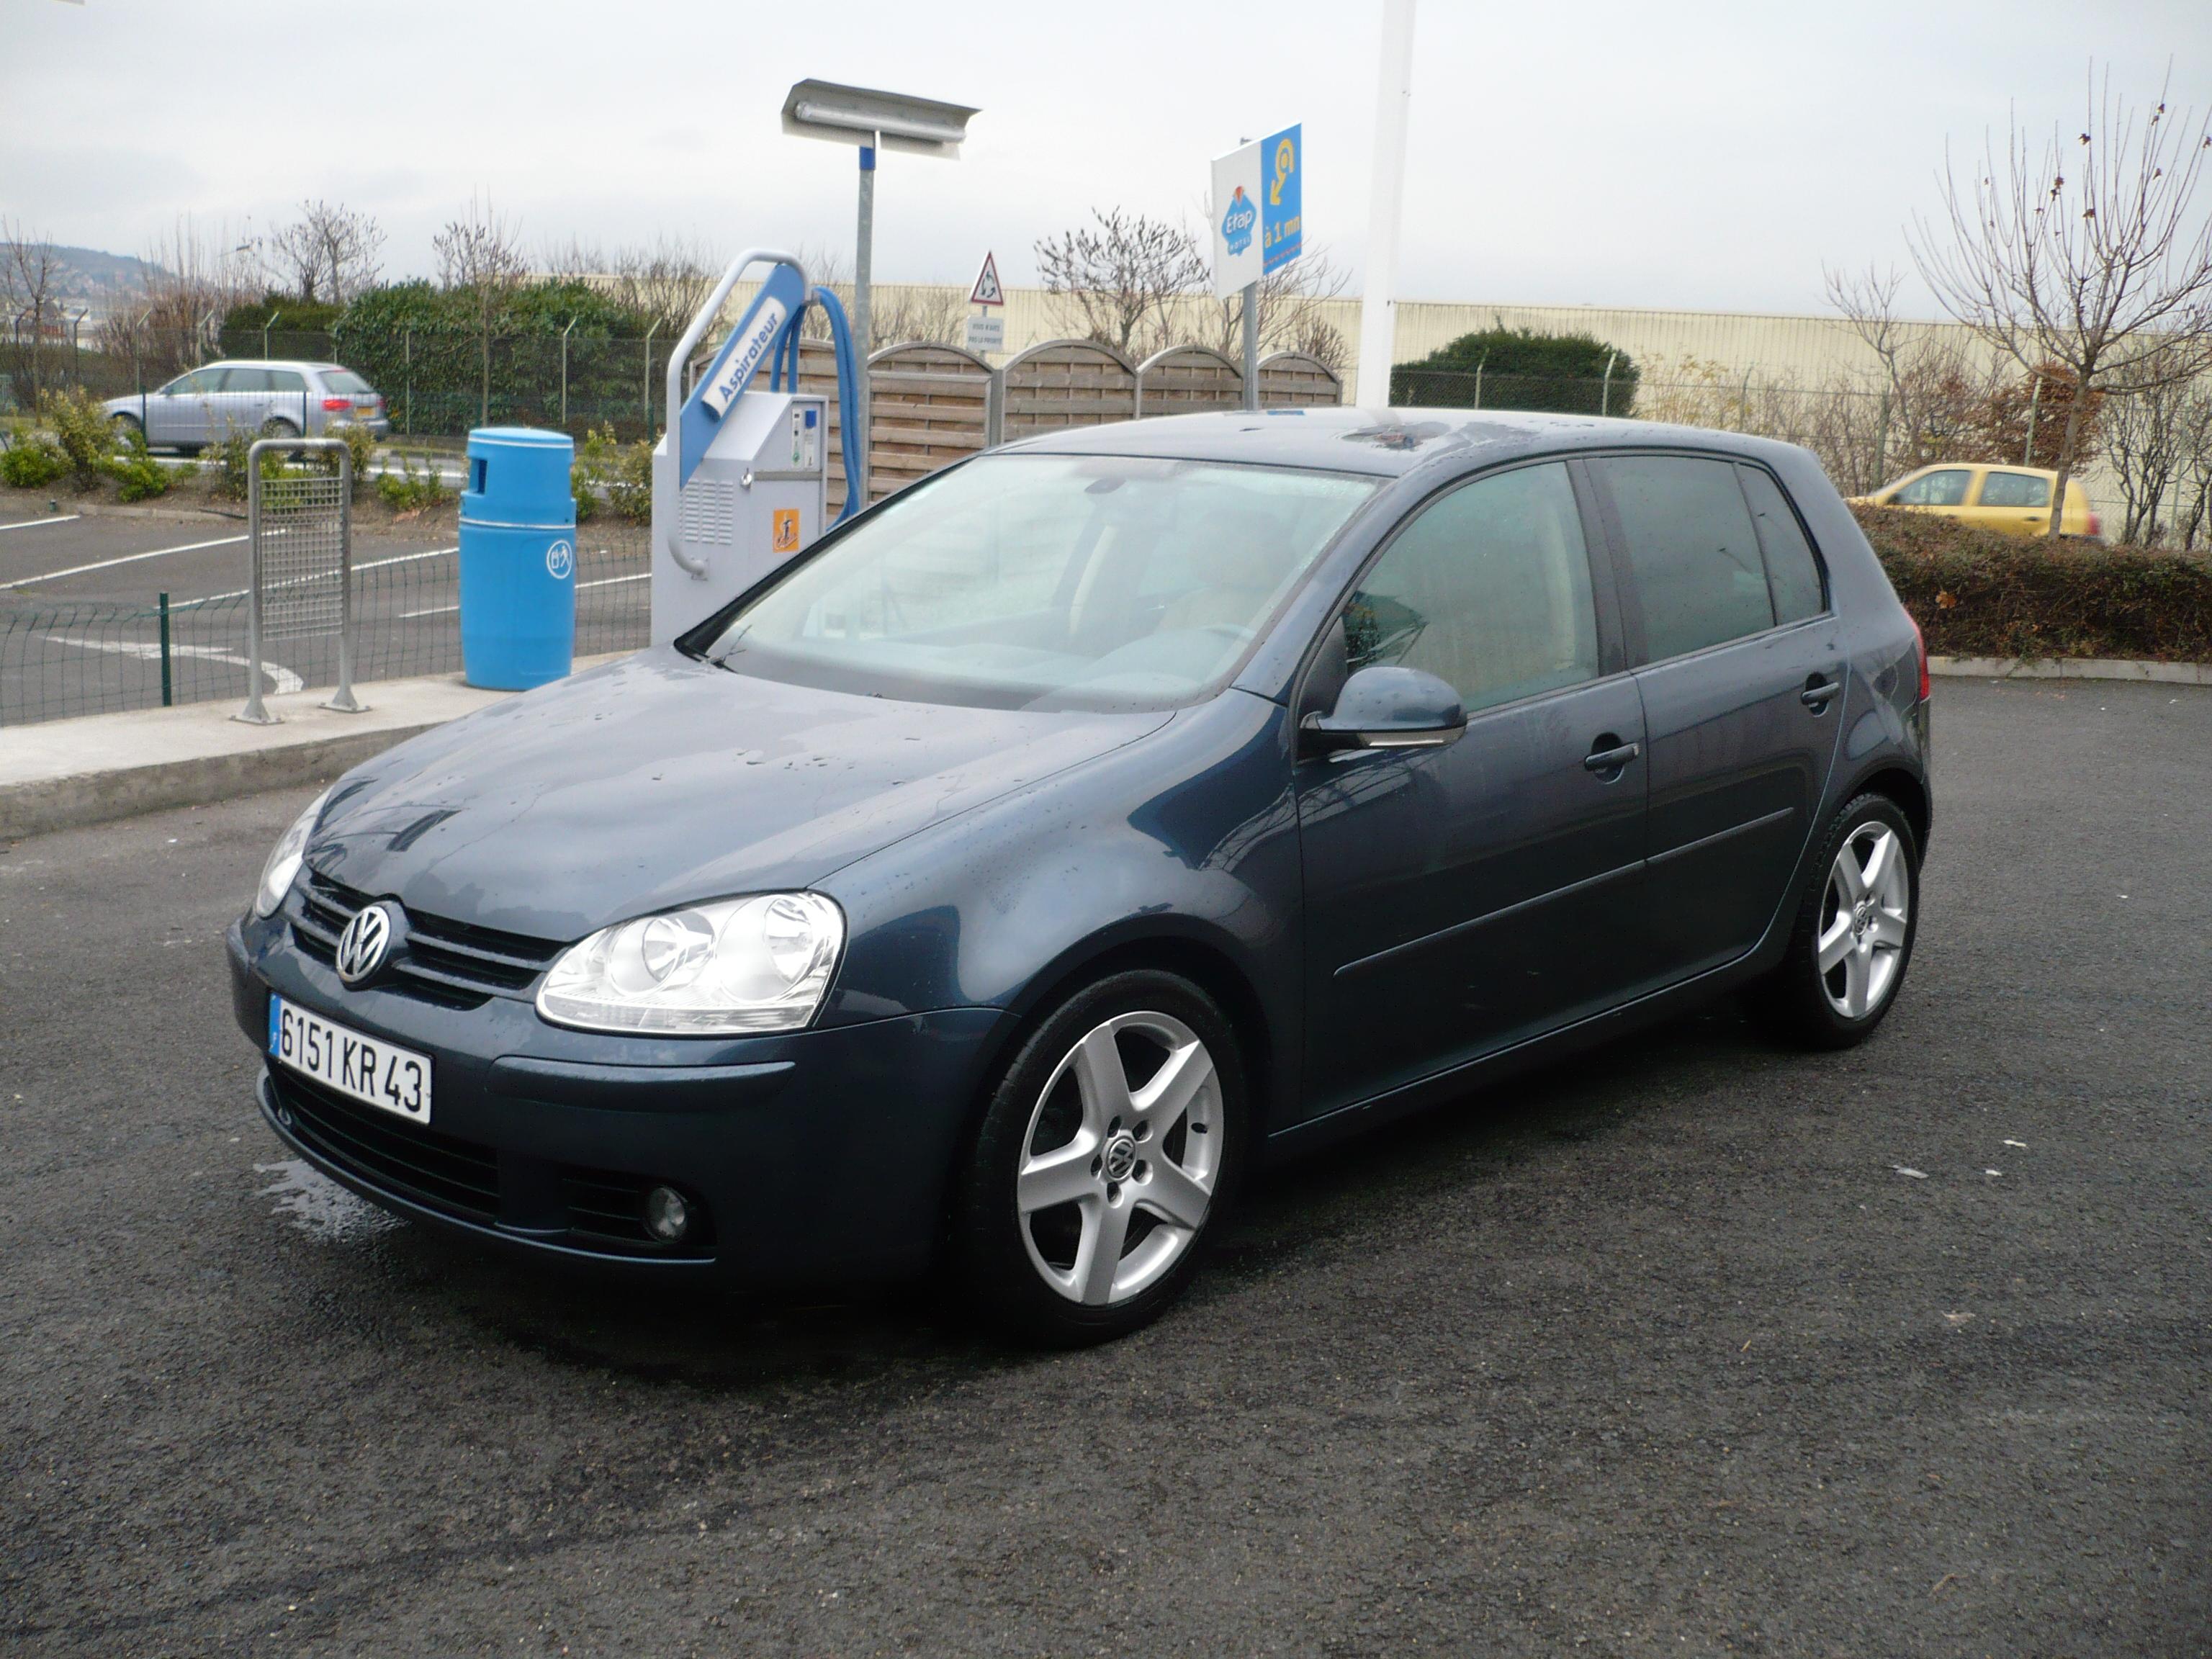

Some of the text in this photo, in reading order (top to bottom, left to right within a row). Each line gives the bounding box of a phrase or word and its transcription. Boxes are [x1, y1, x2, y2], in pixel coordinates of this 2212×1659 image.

[1227, 210, 1253, 234] Etap
[1266, 215, 1300, 248] à 1 mn
[719, 313, 778, 403] Aspirateur
[282, 1007, 423, 1113] 6151 KR 43
